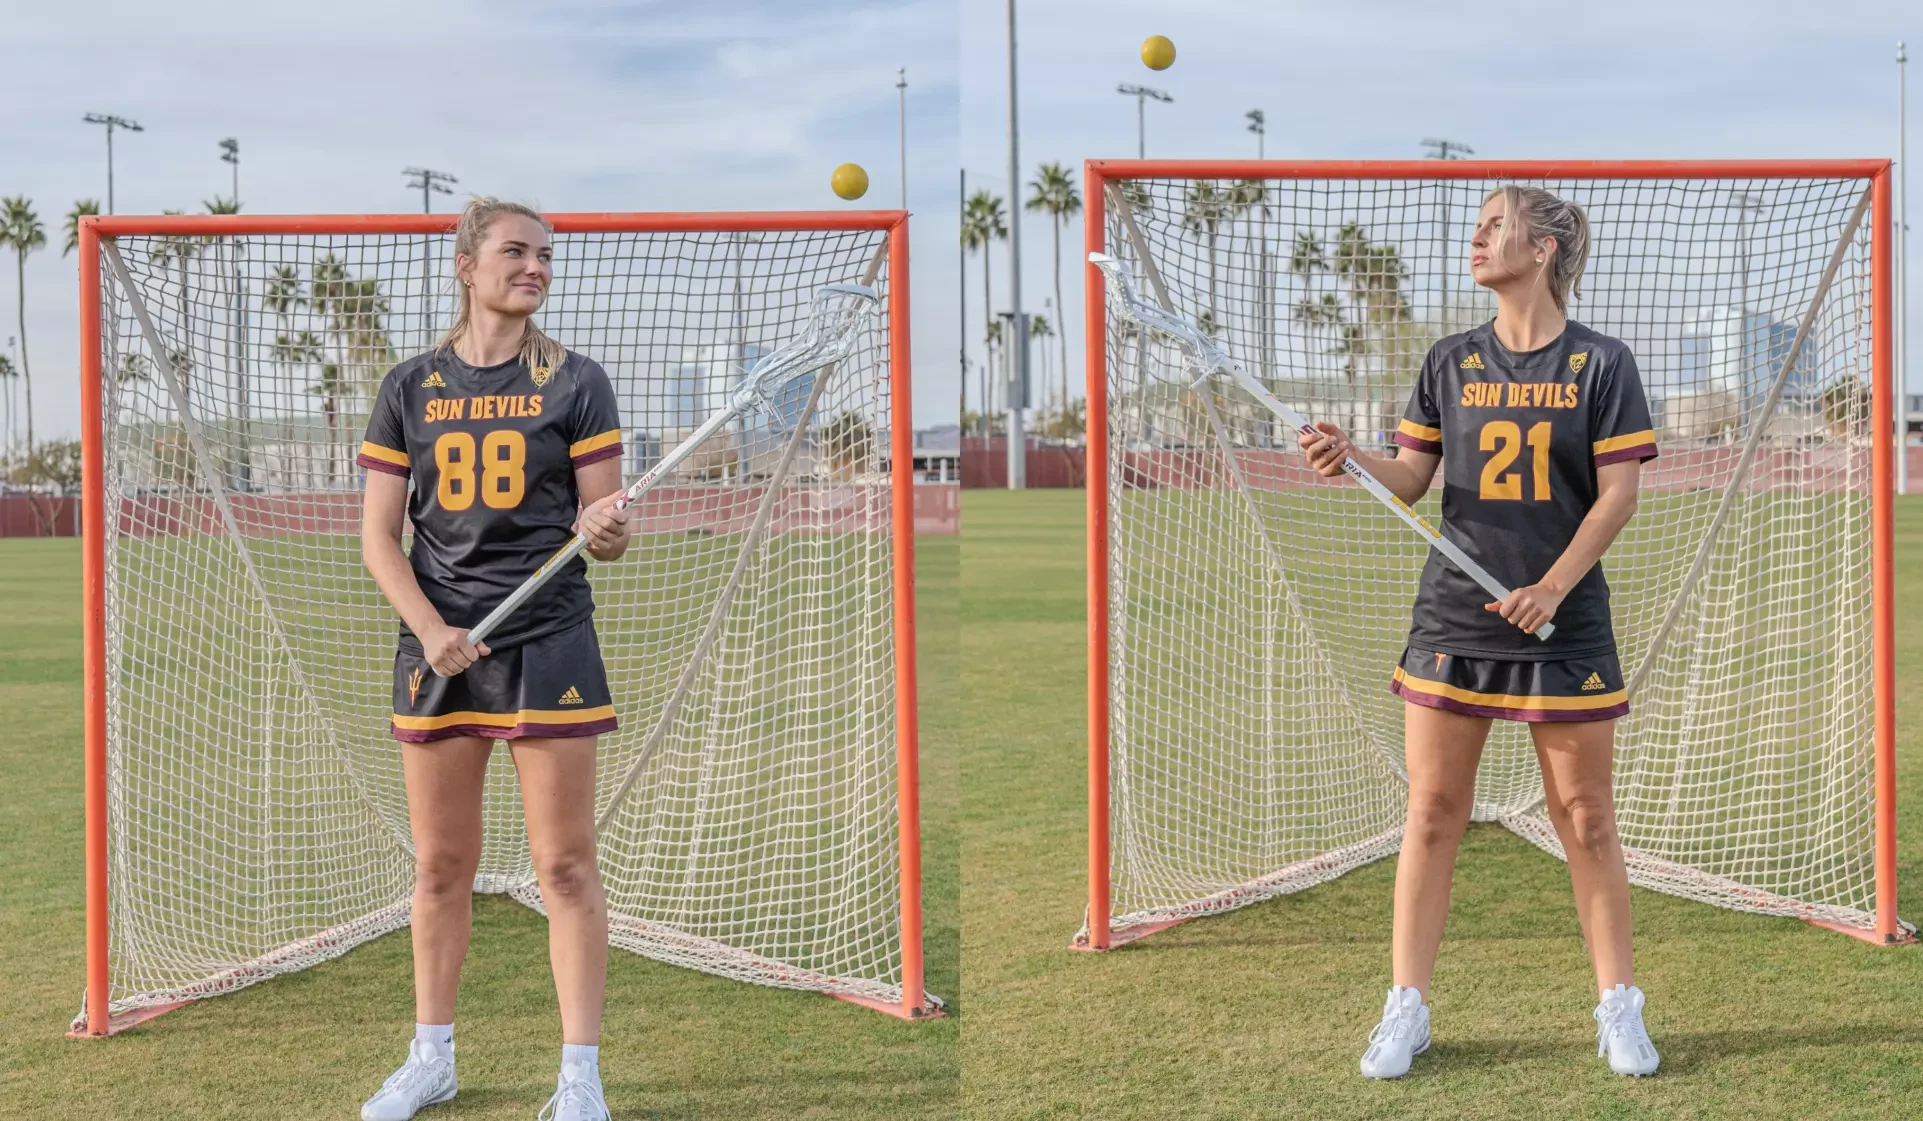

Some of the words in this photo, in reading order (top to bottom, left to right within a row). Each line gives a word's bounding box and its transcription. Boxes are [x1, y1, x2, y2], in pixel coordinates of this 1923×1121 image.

[1460, 362, 1485, 370] adidas
[421, 380, 447, 388] adidas
[1461, 382, 1503, 408] SUN
[1506, 382, 1579, 409] DEVILS
[424, 398, 466, 423] SUN
[469, 394, 544, 420] DEVILS
[434, 429, 527, 511] 88
[1479, 420, 1553, 501] 21
[635, 471, 657, 492] ARIA
[558, 697, 584, 705] adidas
